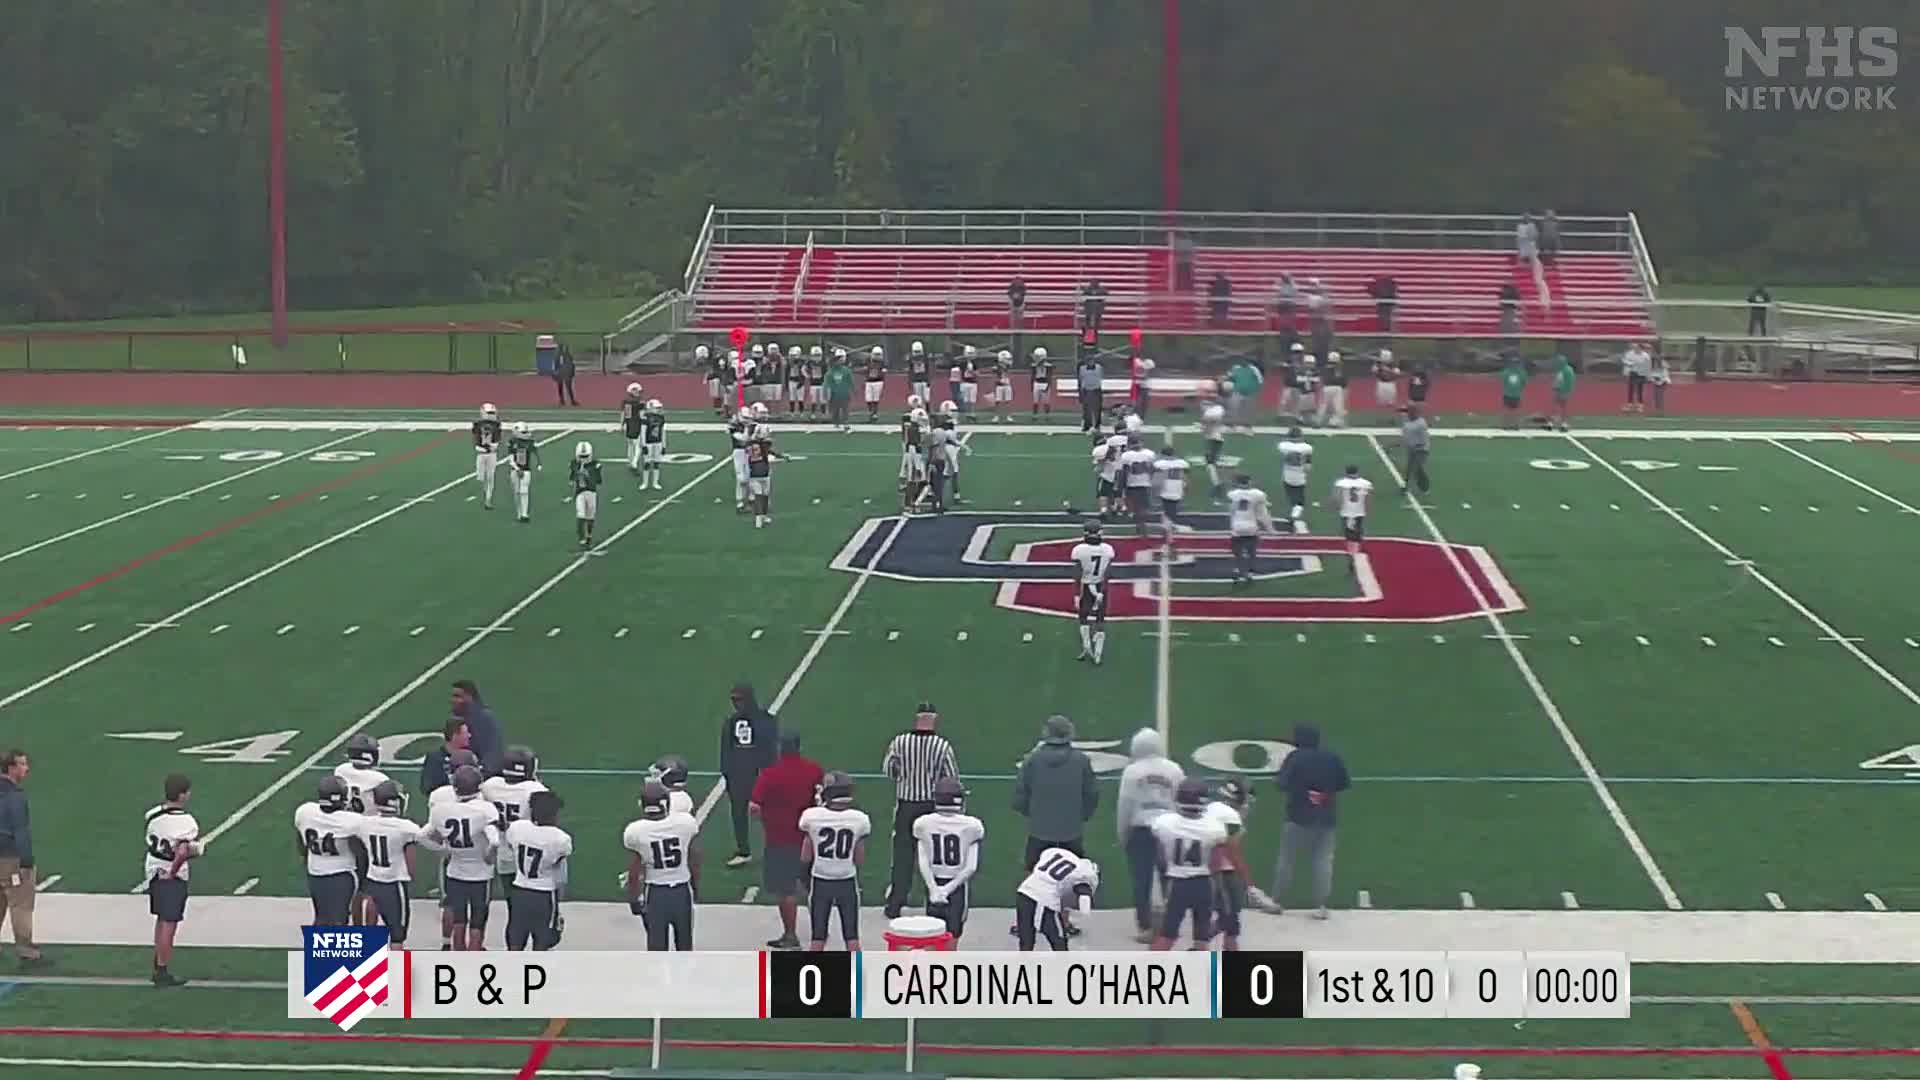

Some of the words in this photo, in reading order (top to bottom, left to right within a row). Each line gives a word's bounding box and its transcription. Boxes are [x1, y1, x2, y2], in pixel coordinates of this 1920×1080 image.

[1090, 555, 1102, 577] 7
[445, 818, 475, 848] 21
[818, 827, 854, 859] 20
[369, 834, 392, 867] 11
[518, 844, 544, 879] 17
[650, 837, 682, 869] 15
[931, 833, 961, 866] 18
[1174, 837, 1202, 867] 14
[1038, 853, 1077, 881] 10
